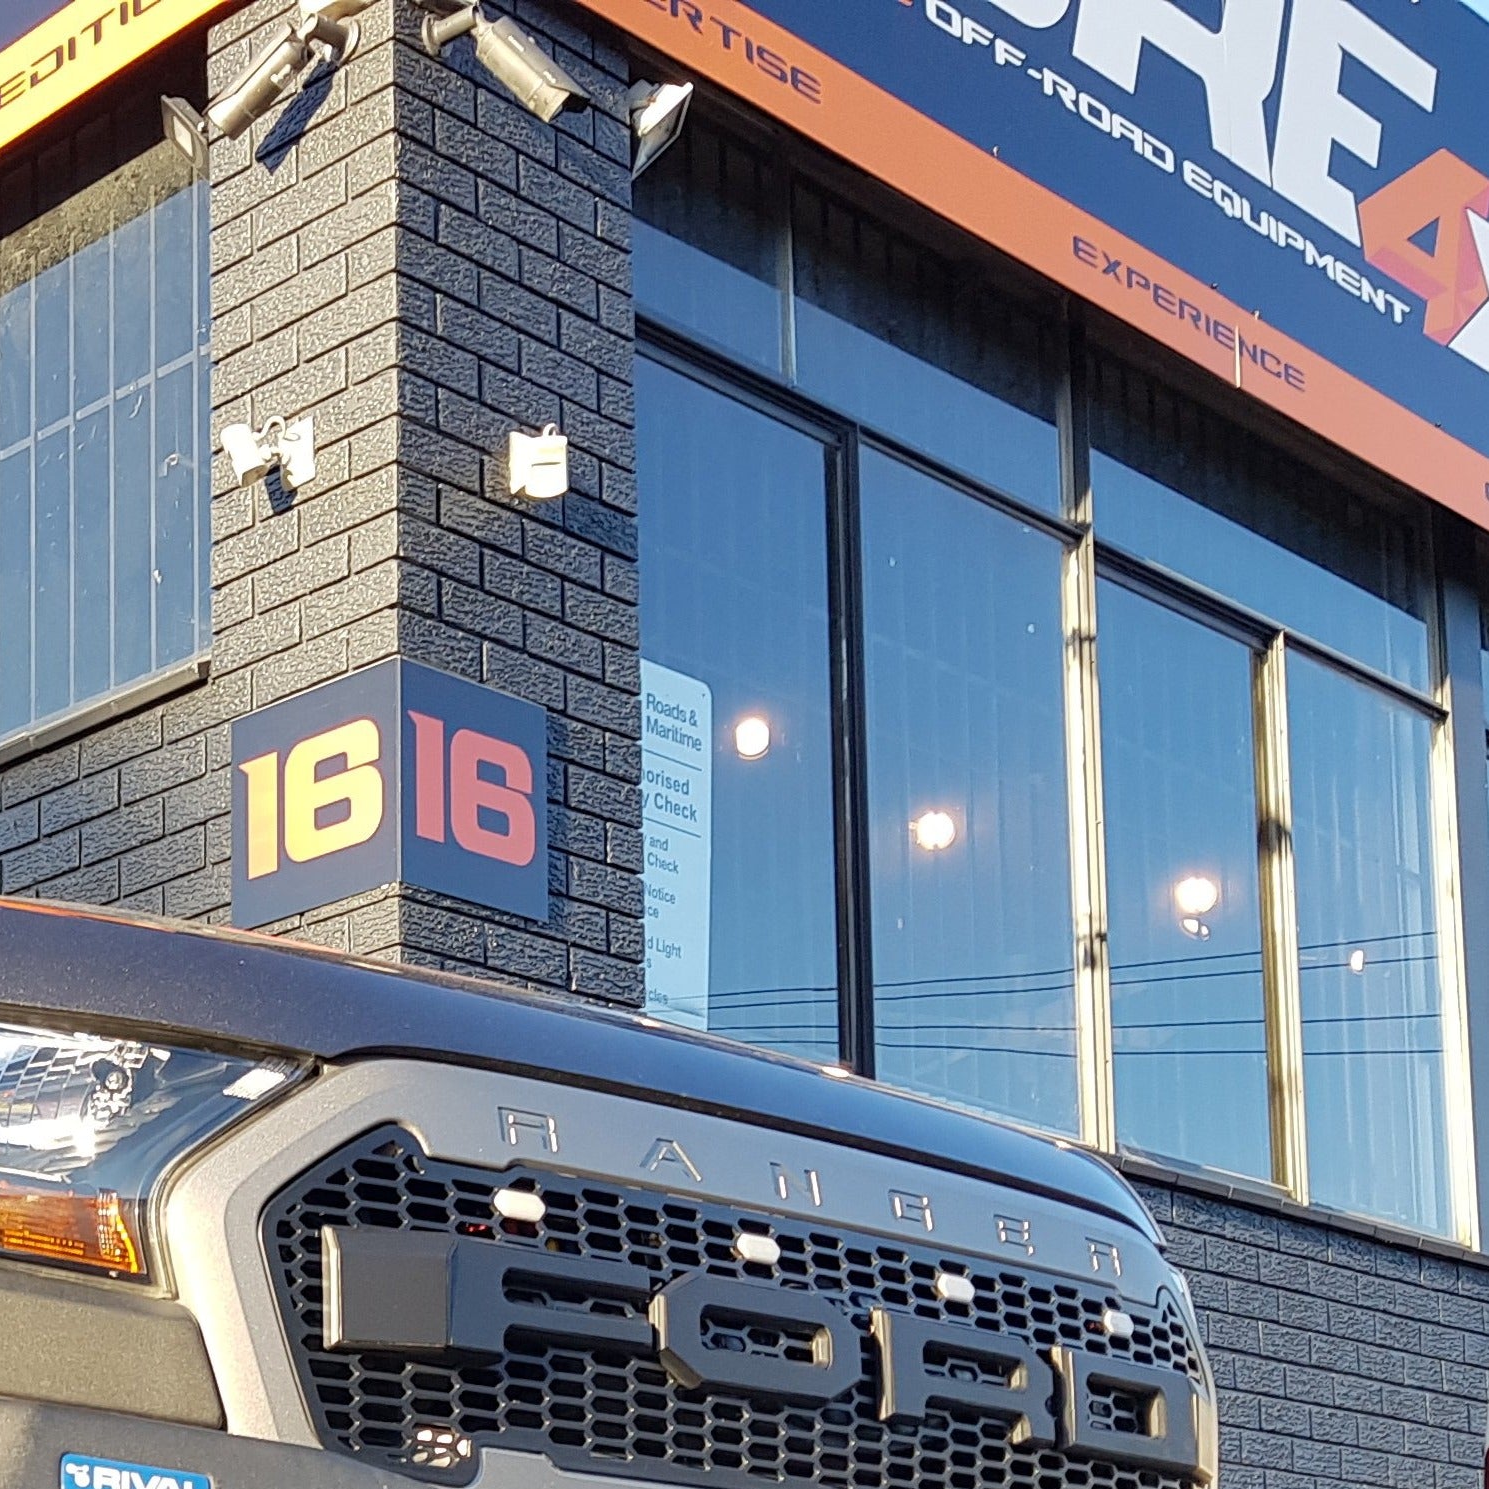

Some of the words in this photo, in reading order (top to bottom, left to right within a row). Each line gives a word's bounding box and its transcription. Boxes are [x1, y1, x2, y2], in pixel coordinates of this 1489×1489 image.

[924, 0, 1175, 174] OFF-ROAD
[1182, 159, 1411, 324] EQUIPMENT
[1072, 234, 1306, 392] EXPERIENCE
[646, 692, 687, 723] Roads
[689, 709, 698, 728] &
[646, 715, 702, 752] Maritime
[238, 718, 384, 881] 16
[407, 709, 536, 867] 16
[654, 792, 698, 822] Check
[647, 851, 679, 875] Check
[649, 835, 669, 852] and
[655, 937, 682, 960] Light
[497, 1105, 1122, 1278] RANGER
[321, 1225, 1215, 1483] FORD
